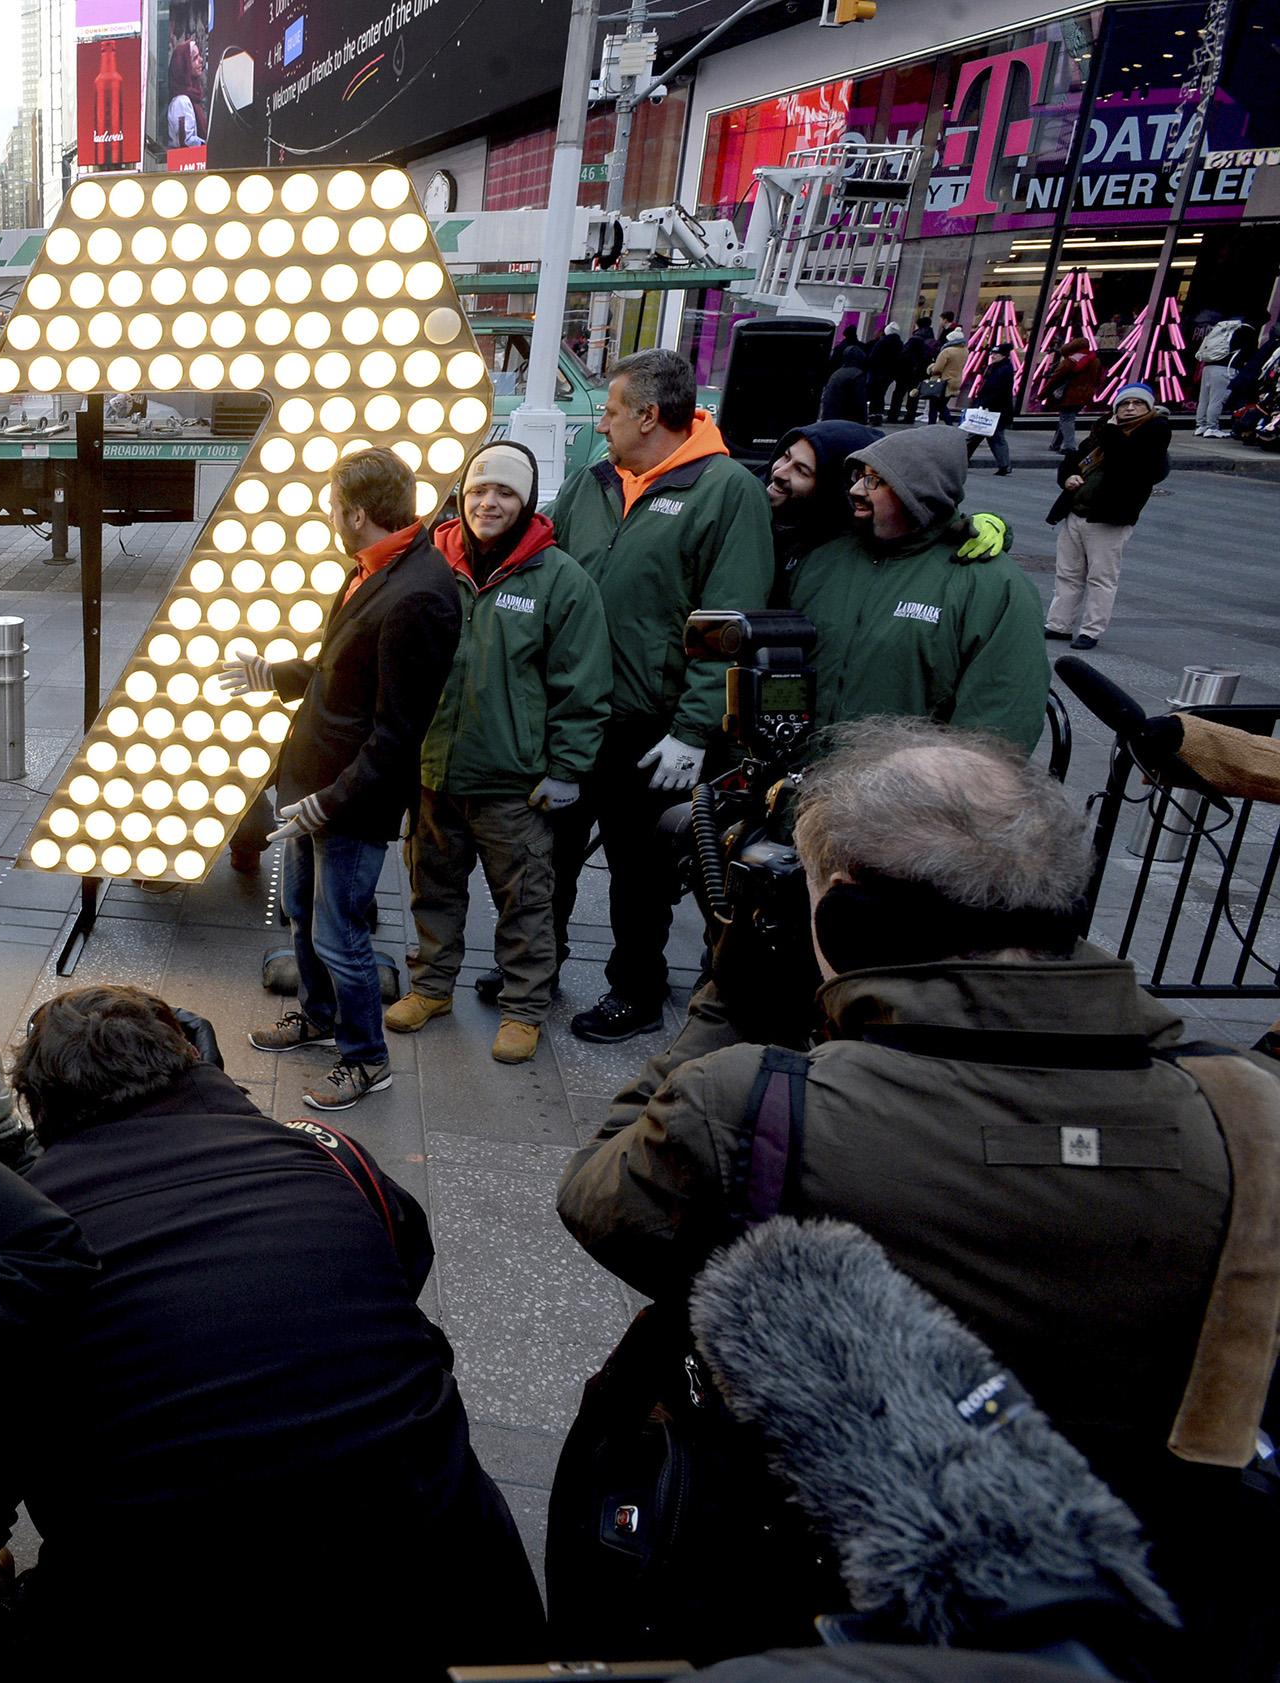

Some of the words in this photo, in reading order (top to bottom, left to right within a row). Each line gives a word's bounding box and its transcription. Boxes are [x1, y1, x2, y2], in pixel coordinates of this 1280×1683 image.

[272, 80, 296, 112] Welcome
[296, 73, 310, 102] your
[310, 50, 333, 85] friends
[334, 50, 342, 71] to
[343, 37, 356, 65] the
[357, 20, 383, 55] center
[384, 3, 396, 37] of
[396, 0, 412, 30] the
[1081, 113, 1211, 165] DATA
[581, 167, 595, 180] 46
[102, 445, 163, 457] BROADWAY
[171, 445, 186, 456] NY
[188, 445, 204, 456] NY
[206, 445, 238, 457] 10019
[495, 591, 537, 610] LANDMARK
[894, 601, 942, 619] LANDMARK
